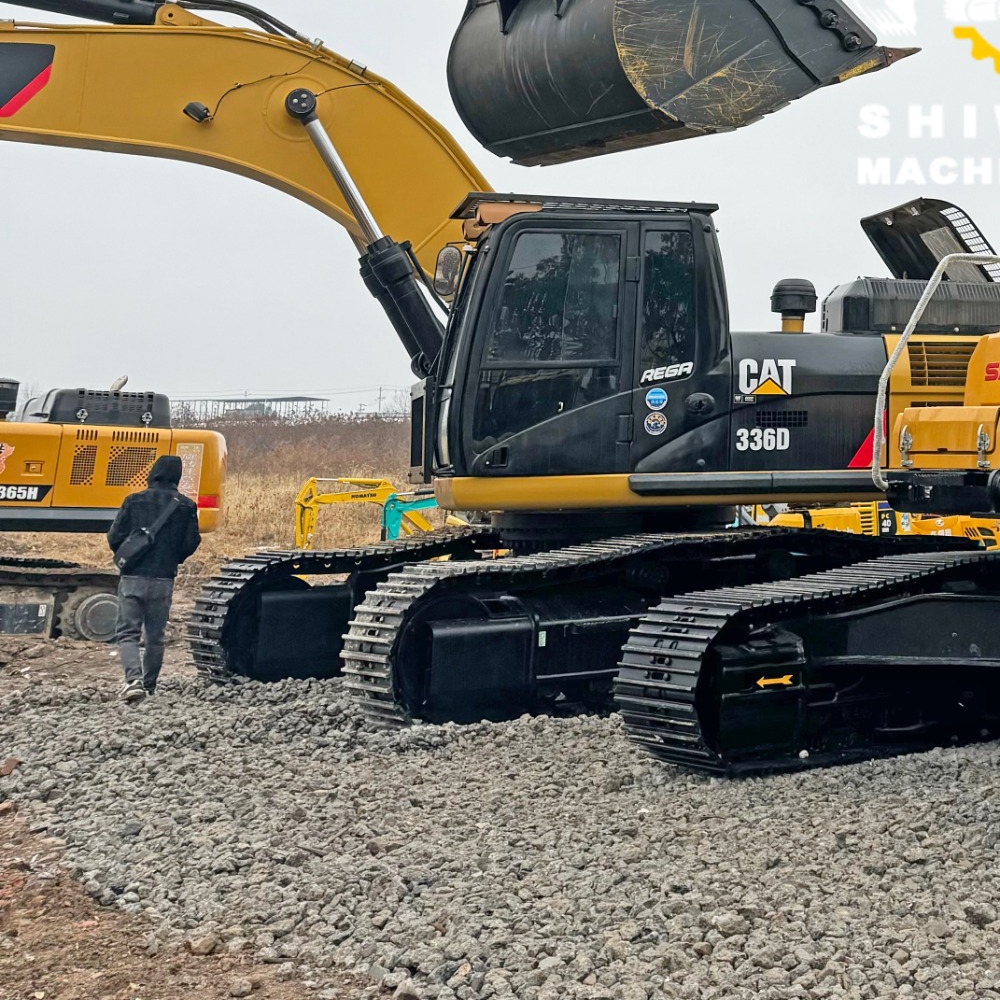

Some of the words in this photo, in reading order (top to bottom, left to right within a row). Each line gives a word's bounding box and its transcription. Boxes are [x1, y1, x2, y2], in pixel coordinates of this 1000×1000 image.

[640, 362, 694, 384] REGA
[738, 358, 797, 395] CAT
[736, 427, 790, 451] 336D
